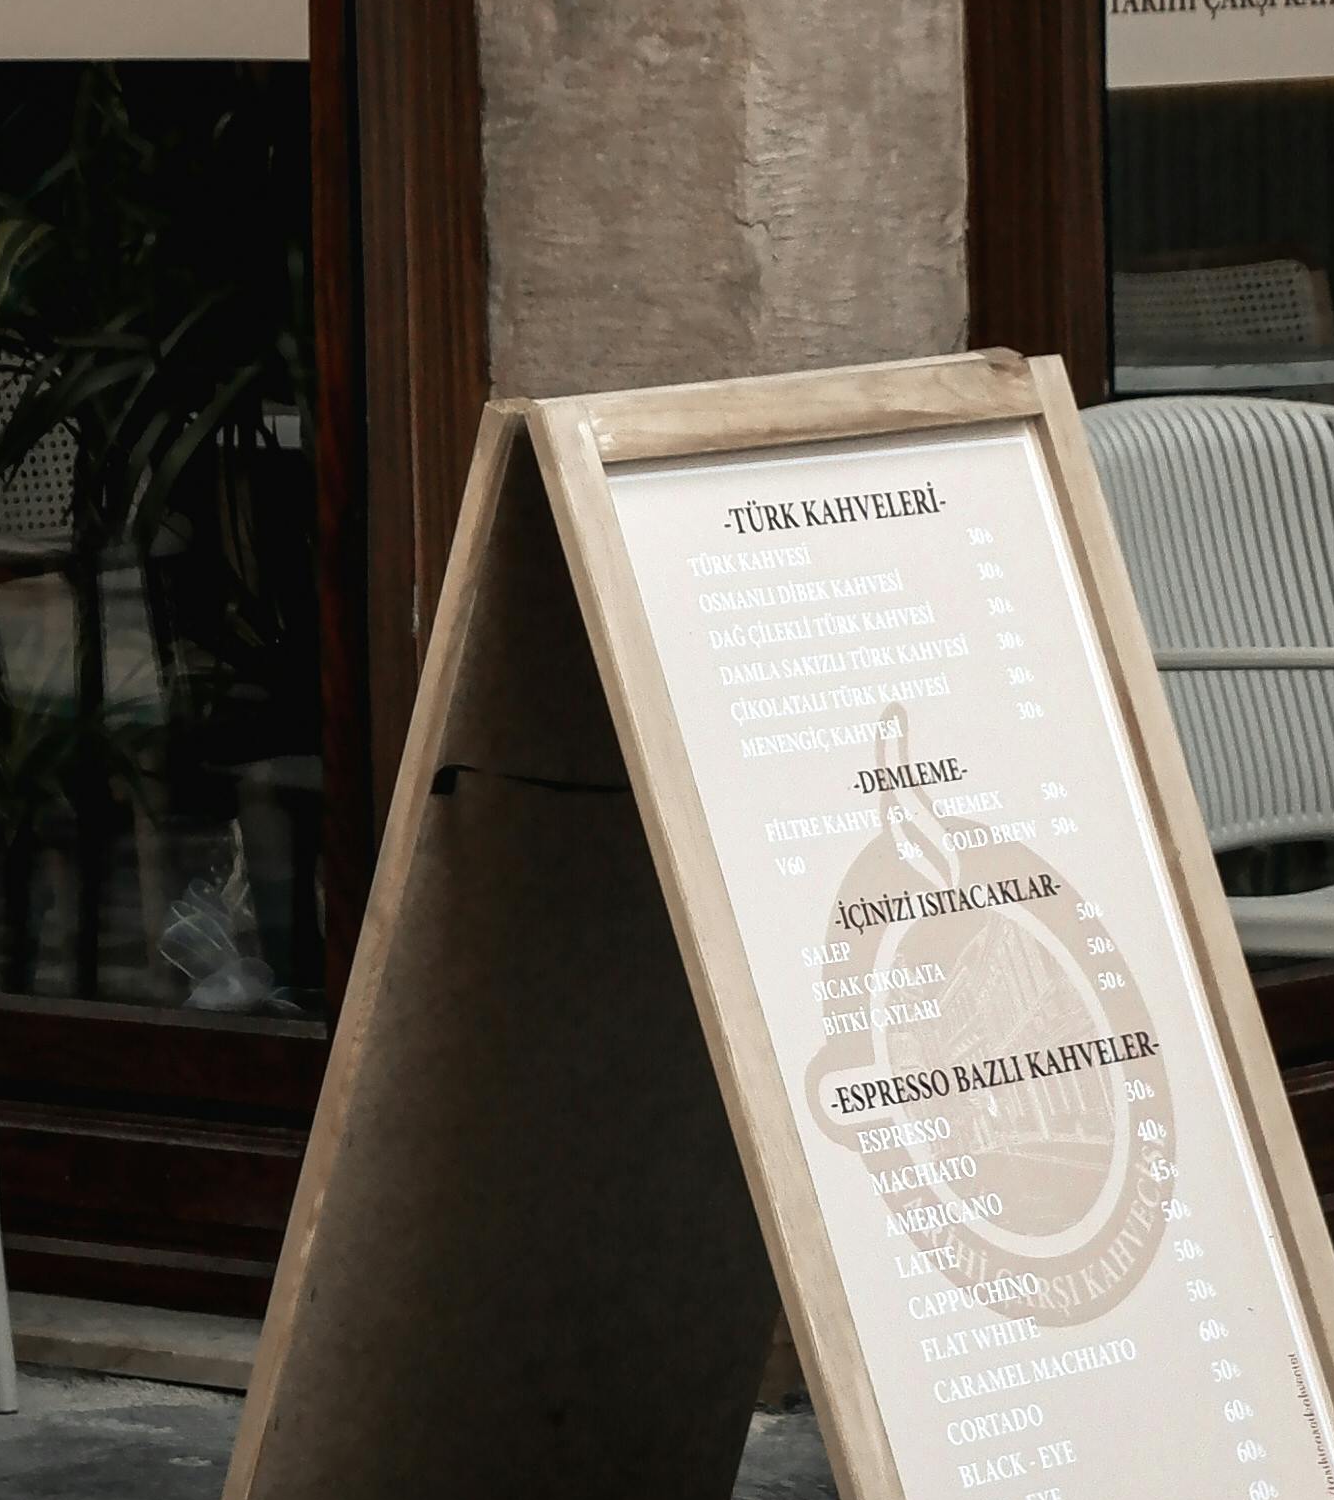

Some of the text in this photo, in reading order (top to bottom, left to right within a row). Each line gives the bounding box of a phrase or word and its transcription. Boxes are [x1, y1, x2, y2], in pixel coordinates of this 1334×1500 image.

[686, 553, 740, 578] TÜRK
[739, 542, 813, 572] KAHVESİ
[698, 589, 776, 614] OSMANLI
[777, 579, 831, 605] DİBEK
[830, 567, 904, 598] KAHVESİ
[707, 623, 747, 651] DAĞ
[748, 615, 813, 650] ÇİLEKLİ
[813, 612, 861, 638] TÜRK
[862, 600, 936, 632] KAHVESİ
[718, 660, 782, 686] DAMLA
[782, 651, 847, 679] SAKIZLI
[848, 646, 900, 673] TÜRK
[899, 632, 970, 663] KAHVESİ
[730, 690, 828, 727] ÇİKOLATALI
[828, 685, 875, 709] TÜRK
[876, 671, 951, 704] KAHVESİ
[740, 726, 830, 759] MENENGİÇ
[830, 715, 905, 748] KAHVESİ
[765, 817, 821, 843] FİLTRE
[822, 808, 881, 833] KAHVE
[932, 790, 1004, 819] CHEMEX
[774, 855, 807, 877] V60
[942, 829, 988, 853] COLD
[990, 819, 1038, 845] BREW
[801, 941, 851, 968] SALEP
[811, 975, 864, 1001] SICAK
[823, 1005, 870, 1036] BİTKİ
[870, 998, 943, 1032] ÇAYLARI
[954, 1057, 1025, 1095] BAZLI
[856, 1116, 952, 1156] ESPRESSO
[868, 1153, 977, 1197] MACHIATO
[885, 1193, 1004, 1239] AMERICANO
[895, 1245, 961, 1280] LATTE
[908, 1272, 1040, 1320] CAPPUCHINO
[920, 1333, 970, 1362] FLAT
[970, 1316, 1042, 1352] WHITE
[933, 1361, 1031, 1404] CARAMEL
[1033, 1338, 1137, 1383] MACHIATO
[947, 1403, 1044, 1446] CORTADO
[958, 1451, 1027, 1489] BLACK
[1037, 1439, 1077, 1471] EYE
